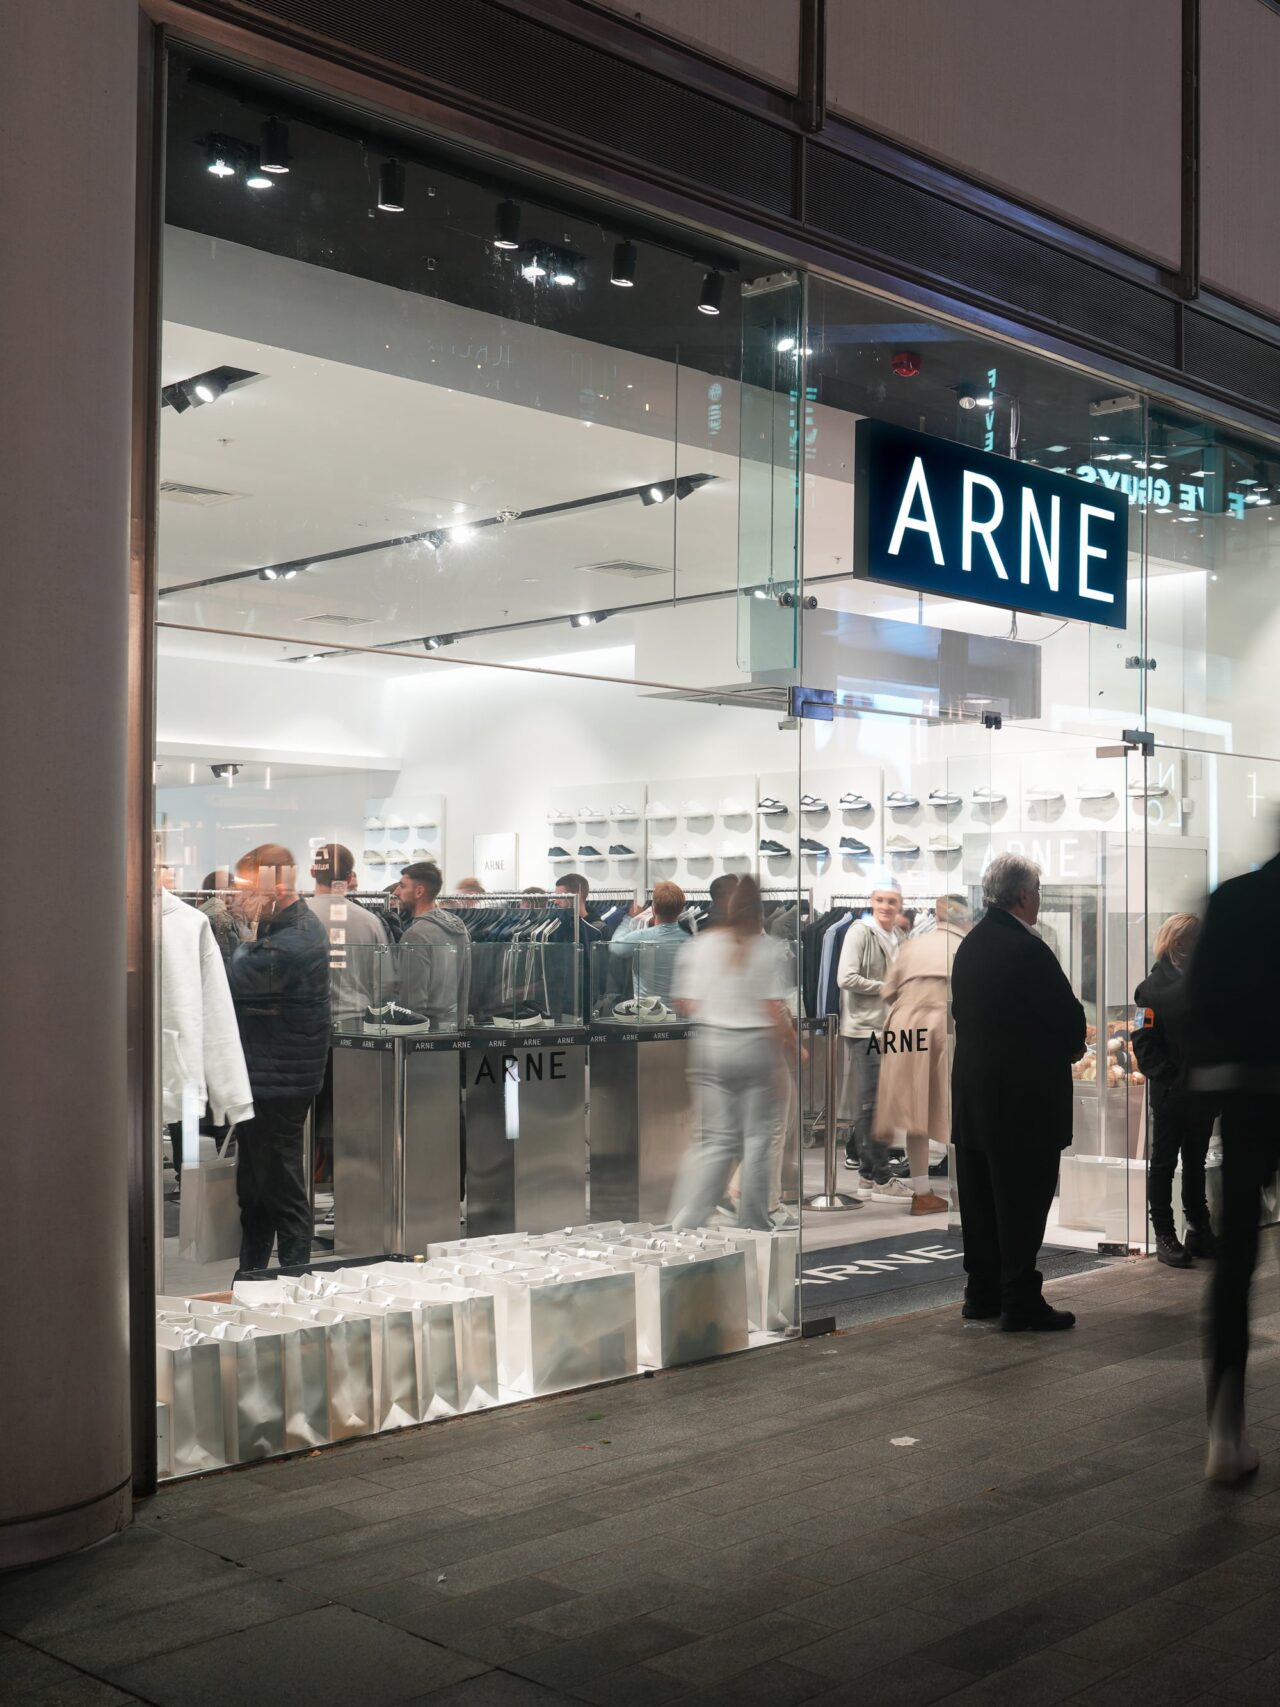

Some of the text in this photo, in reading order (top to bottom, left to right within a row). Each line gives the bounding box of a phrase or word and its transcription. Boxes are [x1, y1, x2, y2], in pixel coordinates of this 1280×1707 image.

[888, 456, 1115, 603] ARNE
[485, 860, 505, 871] ARNE
[362, 1041, 375, 1049] ARNE
[524, 1038, 542, 1046] ARNE
[866, 1028, 928, 1056] ARNE
[474, 1051, 566, 1085] ARNE
